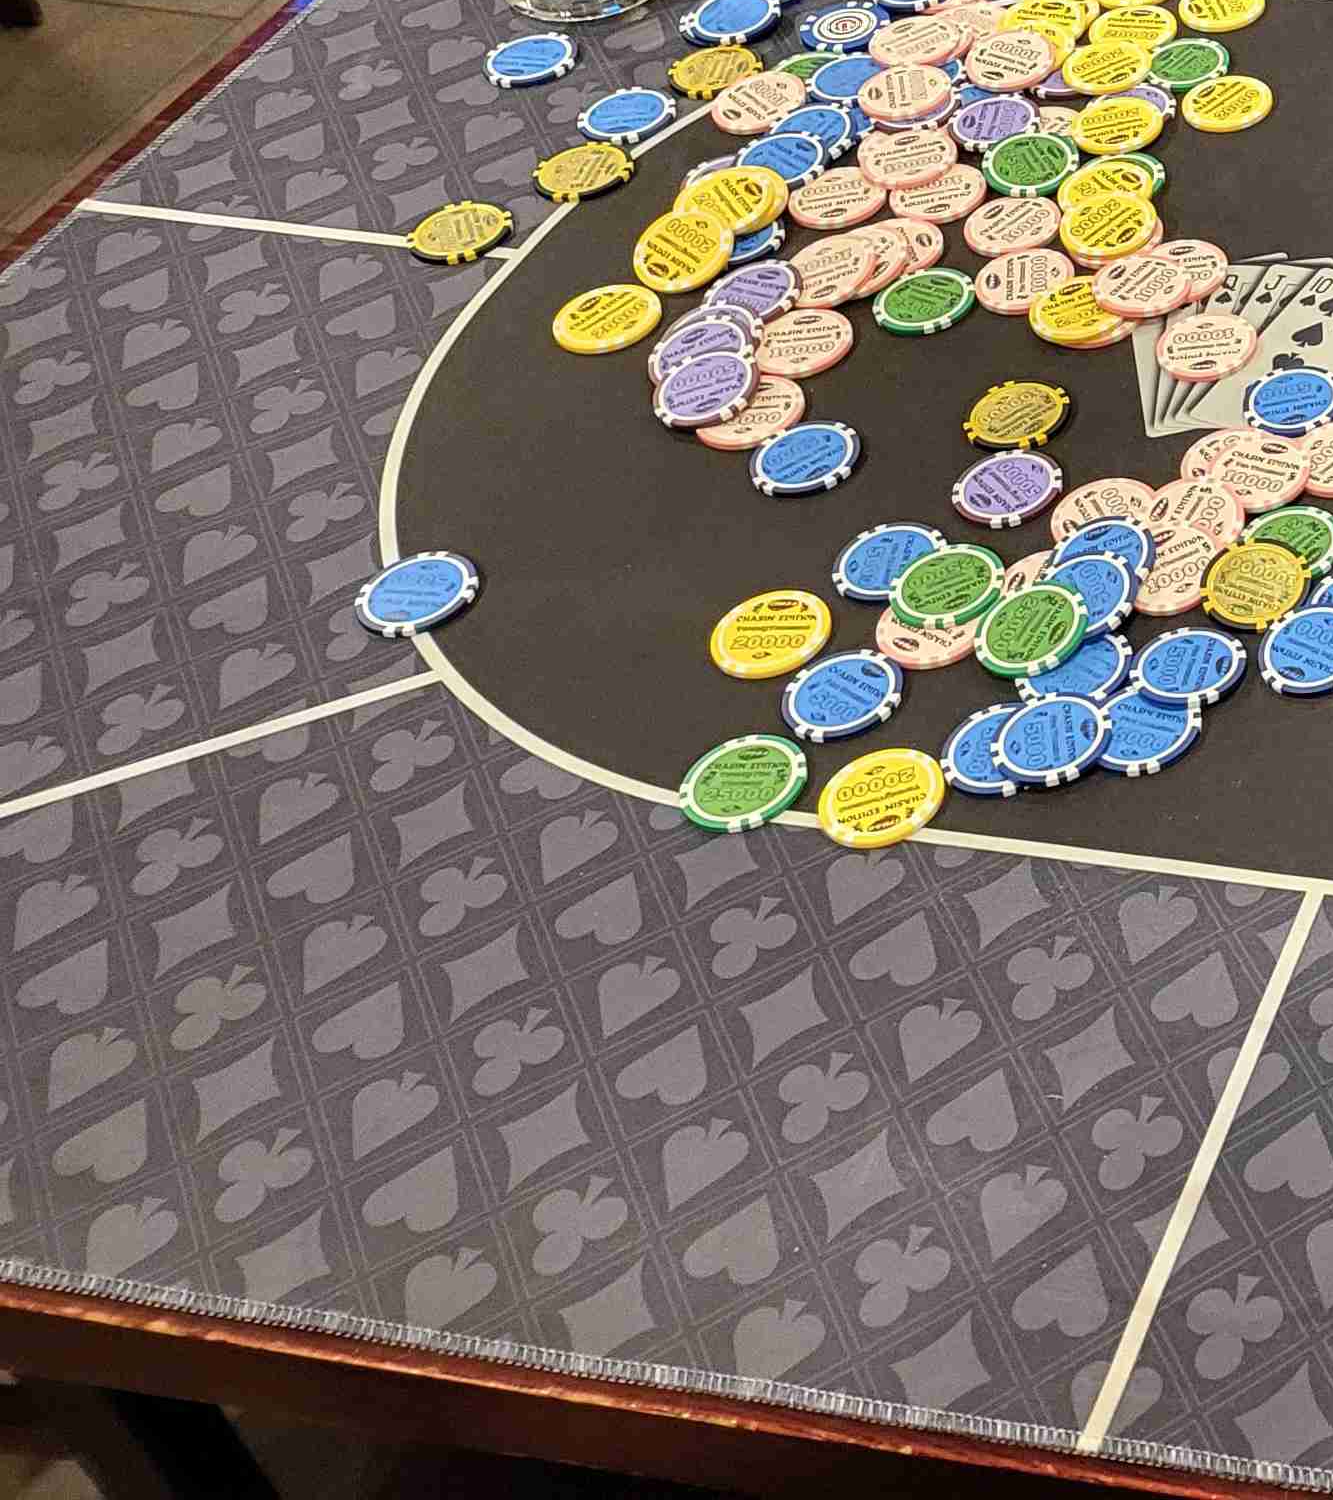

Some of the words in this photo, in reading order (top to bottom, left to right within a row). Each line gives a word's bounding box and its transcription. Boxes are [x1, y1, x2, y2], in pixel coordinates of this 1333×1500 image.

[665, 218, 716, 253] 20000
[1223, 275, 1239, 291] Q
[1264, 275, 1286, 290] J
[1309, 276, 1333, 293] 10
[1221, 469, 1284, 492] 10000
[778, 613, 818, 622] EDITION
[730, 634, 806, 650] 20000
[836, 766, 916, 802] 20000
[703, 786, 777, 802] 25000
[837, 807, 880, 825] EDITION
